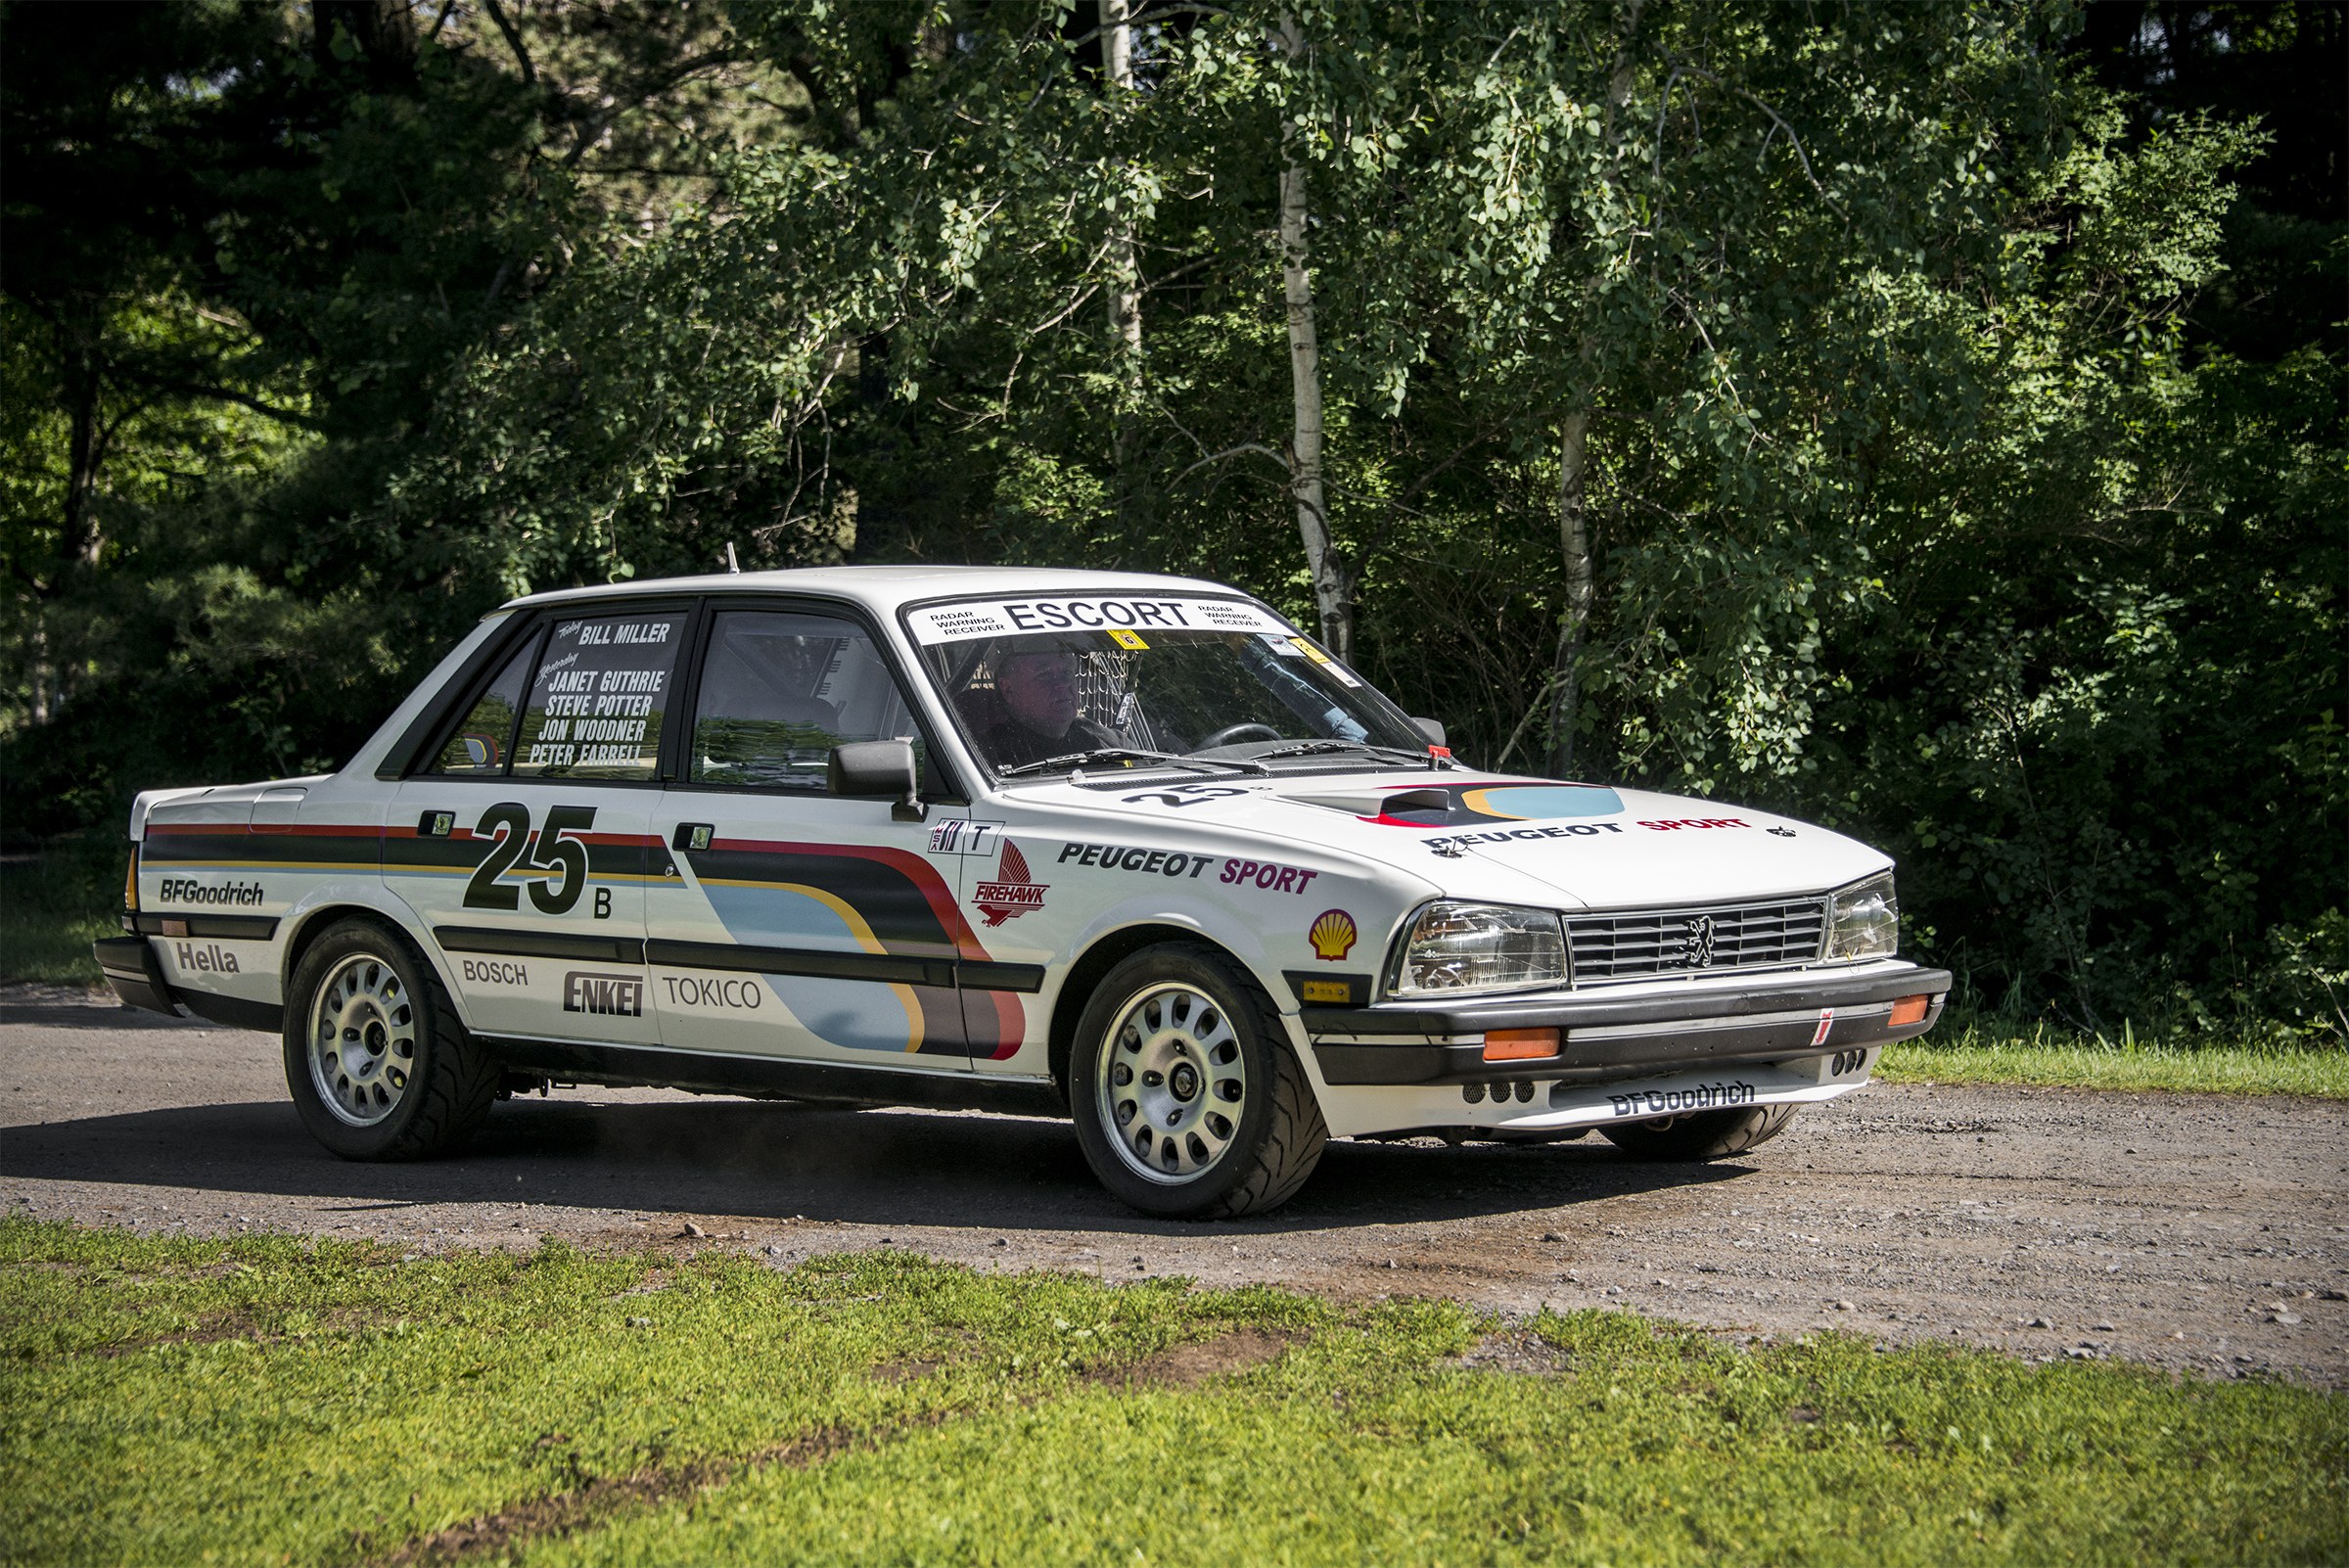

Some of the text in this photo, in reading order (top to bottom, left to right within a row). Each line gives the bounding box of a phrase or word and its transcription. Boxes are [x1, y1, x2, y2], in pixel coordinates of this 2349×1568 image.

[930, 611, 974, 622] RADAR
[936, 618, 995, 628] WARNING
[944, 623, 1005, 635] RECEIVER
[1003, 601, 1189, 630] ESCORT
[1213, 619, 1263, 627] RECEIVER
[558, 620, 670, 645] Today BILL MILLER
[533, 652, 579, 687] Yesterday
[548, 670, 665, 692] JANET GUTHRIE
[545, 695, 653, 716] STEVE POTTER
[538, 719, 647, 742] JON WOODNER
[529, 744, 642, 767] PETER FARRELL
[1121, 785, 1248, 808] 25
[971, 825, 991, 852] T
[1420, 817, 1753, 850] PEUGEOT SPORT
[462, 801, 612, 919] 25 B
[1057, 843, 1317, 895] PEUGEOT SPORT
[160, 879, 264, 906] BFGoodrich
[975, 885, 1046, 903] FIREHAWK
[176, 942, 240, 974] Hella
[463, 960, 529, 987] BOSCH
[563, 971, 644, 1017] ENKEI
[662, 977, 761, 1009] TOKICO
[1605, 1080, 1755, 1116] BFGoodrich
